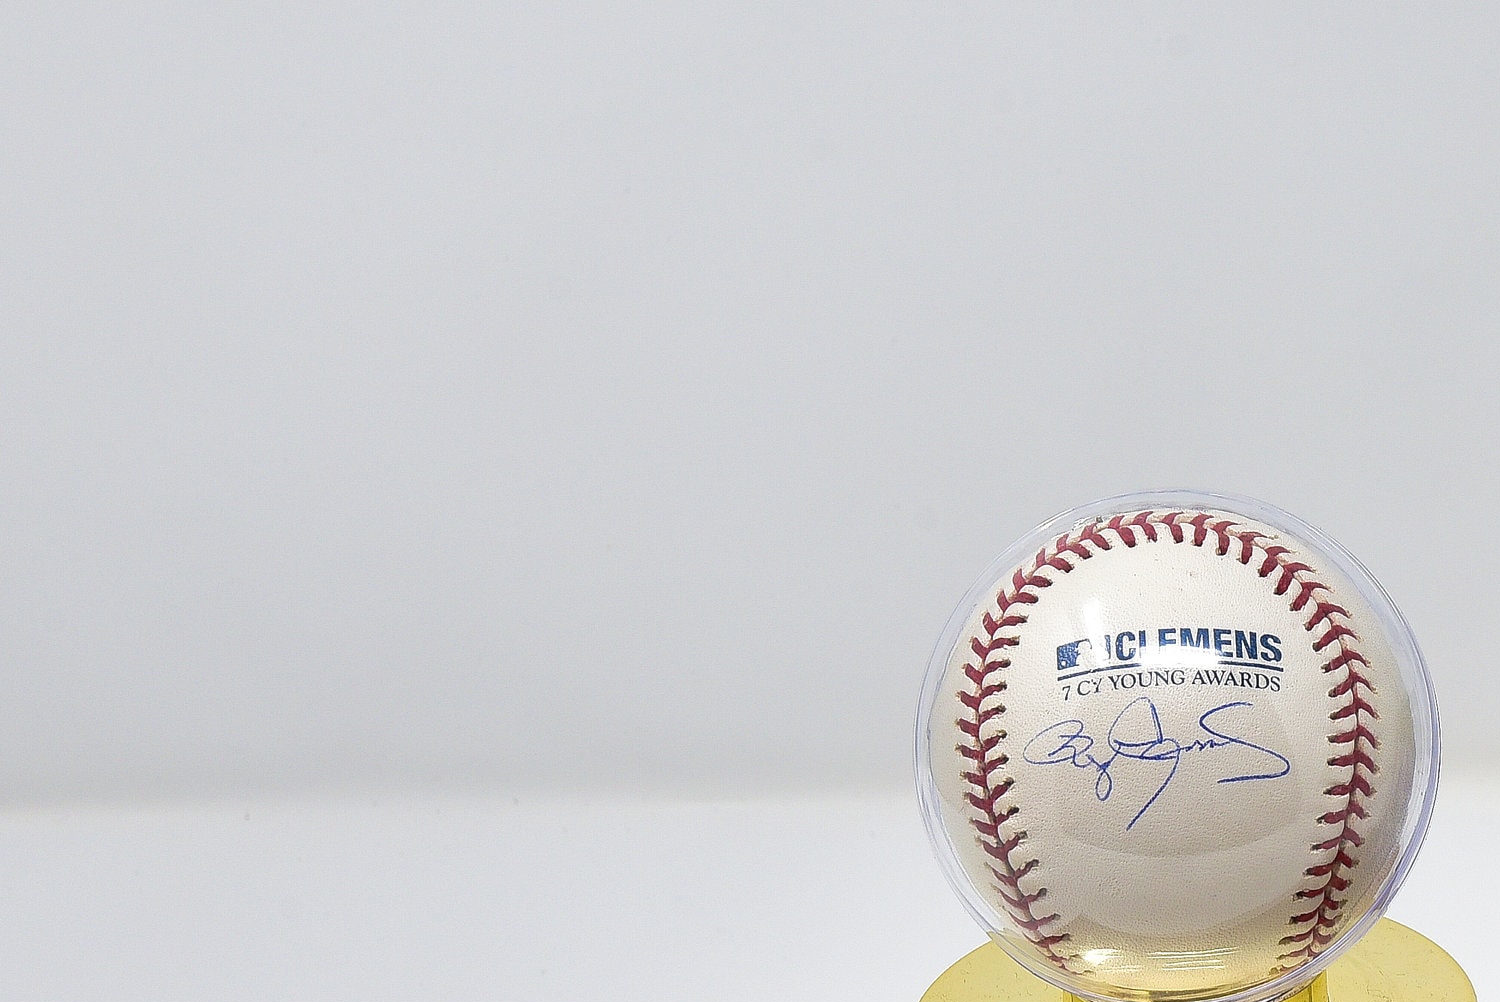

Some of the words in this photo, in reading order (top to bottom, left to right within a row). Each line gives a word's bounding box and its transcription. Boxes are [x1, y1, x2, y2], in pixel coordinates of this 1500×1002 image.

[1062, 685, 1071, 701] 7
[1077, 678, 1102, 697] CY
[1108, 669, 1185, 690] YOUNG
[1192, 669, 1281, 692] AWARDS
